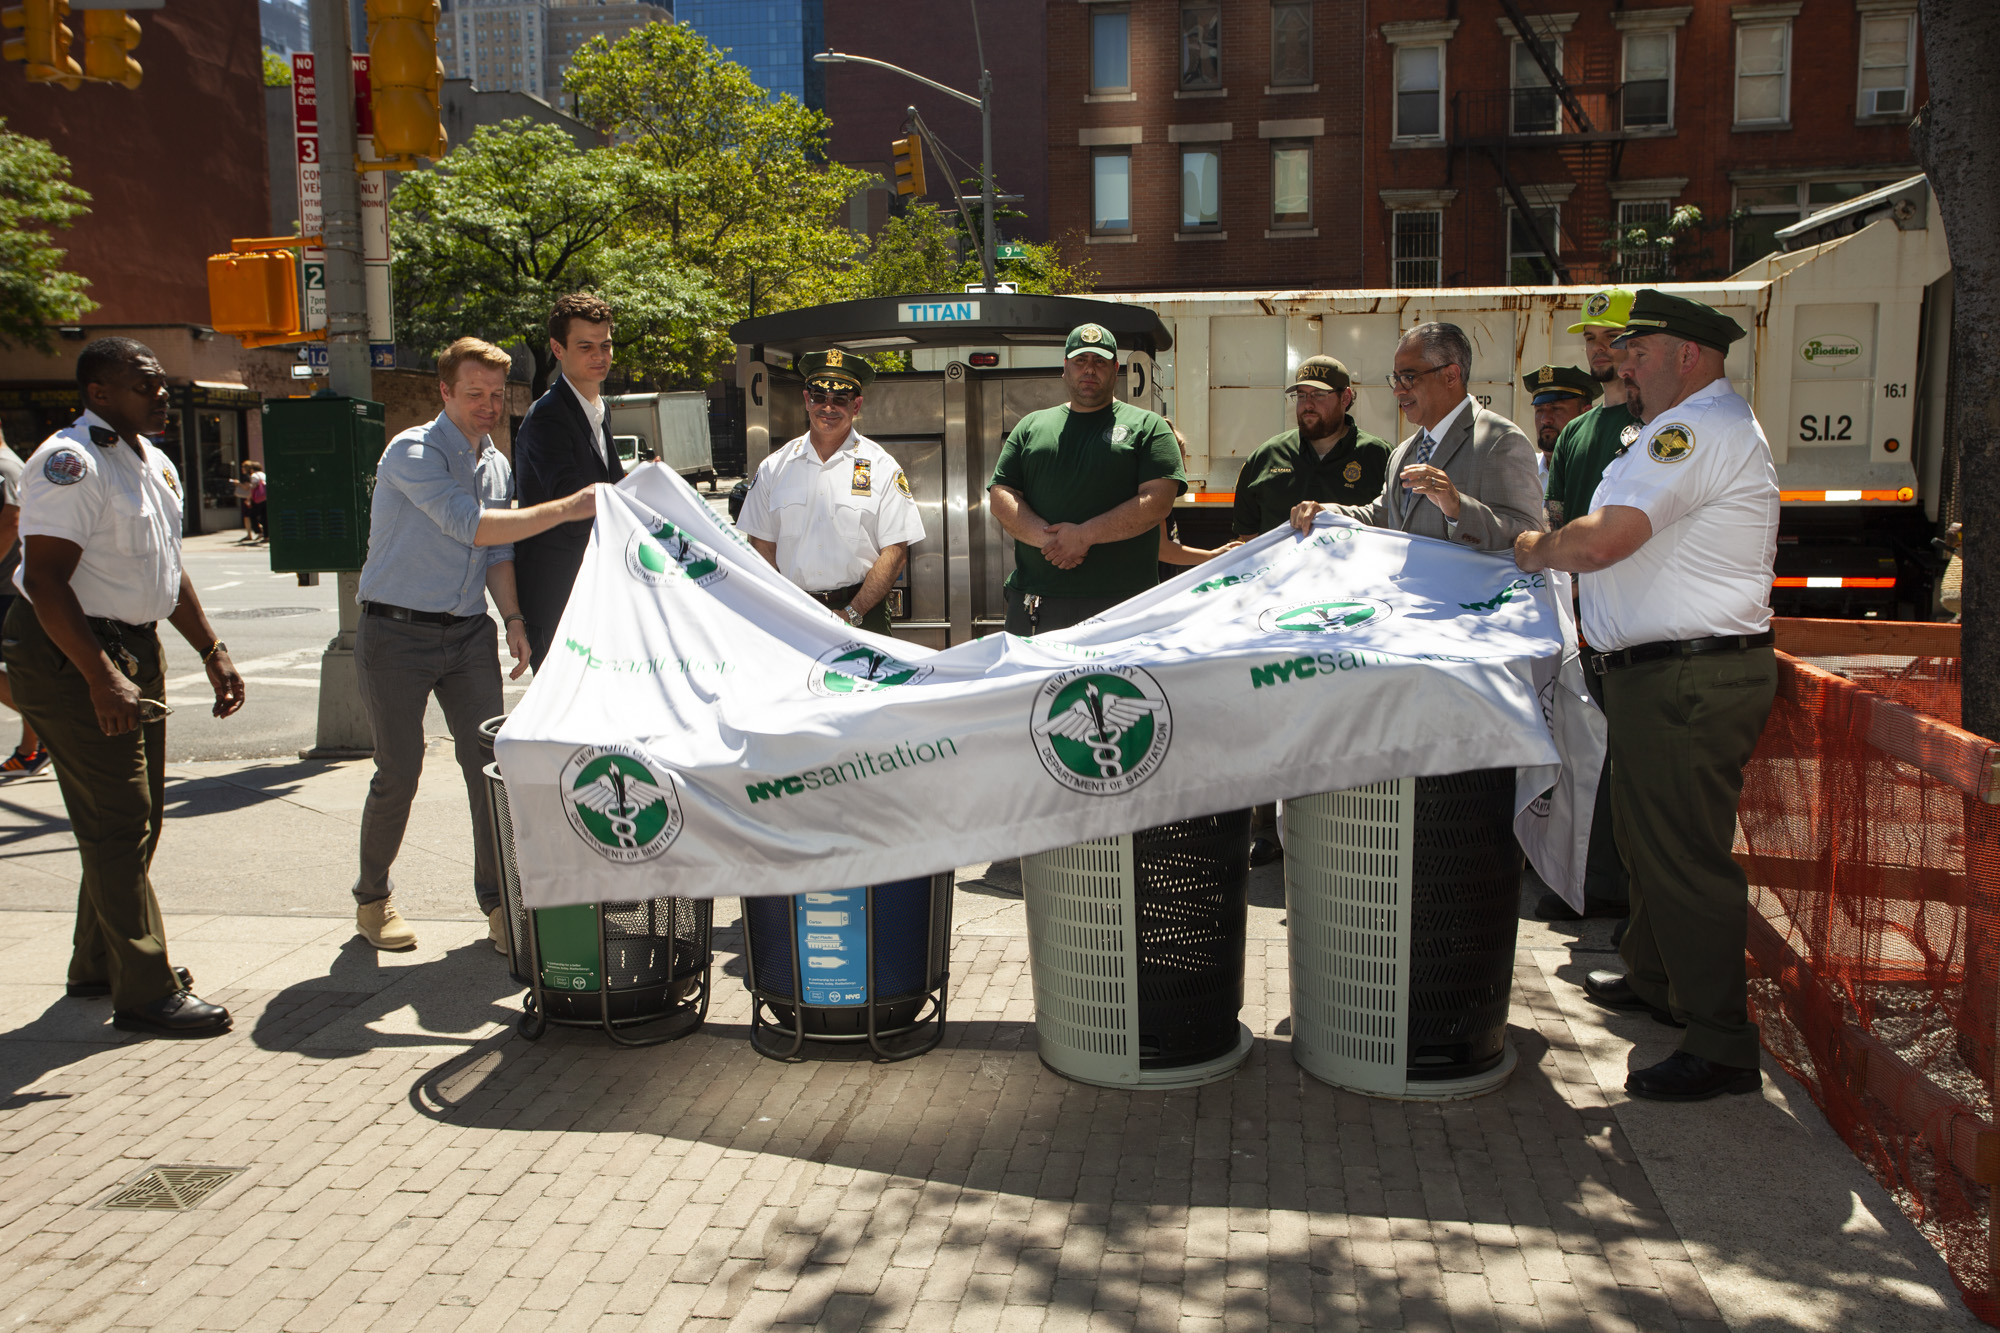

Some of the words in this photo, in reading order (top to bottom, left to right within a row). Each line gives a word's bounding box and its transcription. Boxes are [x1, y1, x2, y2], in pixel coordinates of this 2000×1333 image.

[296, 58, 312, 70] NO
[297, 74, 314, 84] 7am
[298, 86, 316, 96] 4pm
[298, 96, 318, 105] Exce
[302, 140, 316, 162] 3
[361, 184, 378, 194] NLY
[361, 200, 384, 208] NDING
[1004, 246, 1012, 257] 9
[308, 266, 322, 289] 2
[310, 306, 327, 314] Exce
[908, 302, 972, 322] TITAN
[1812, 346, 1858, 355] Biodiesel
[1297, 366, 1330, 378] DSNY
[1884, 384, 1906, 398] 16.1
[1800, 414, 1852, 442] S.I.2
[1044, 672, 1068, 697] NEW
[1109, 664, 1138, 679] CITY
[574, 746, 595, 768] NEW
[1042, 747, 1106, 791] DEPARTMENT
[1110, 780, 1122, 790] OF
[1126, 722, 1168, 786] SANITATION
[745, 736, 958, 803] NYCsanitation
[571, 811, 625, 859] DEPARTMENT
[627, 850, 639, 860] OF
[641, 809, 680, 856] SANITATION
